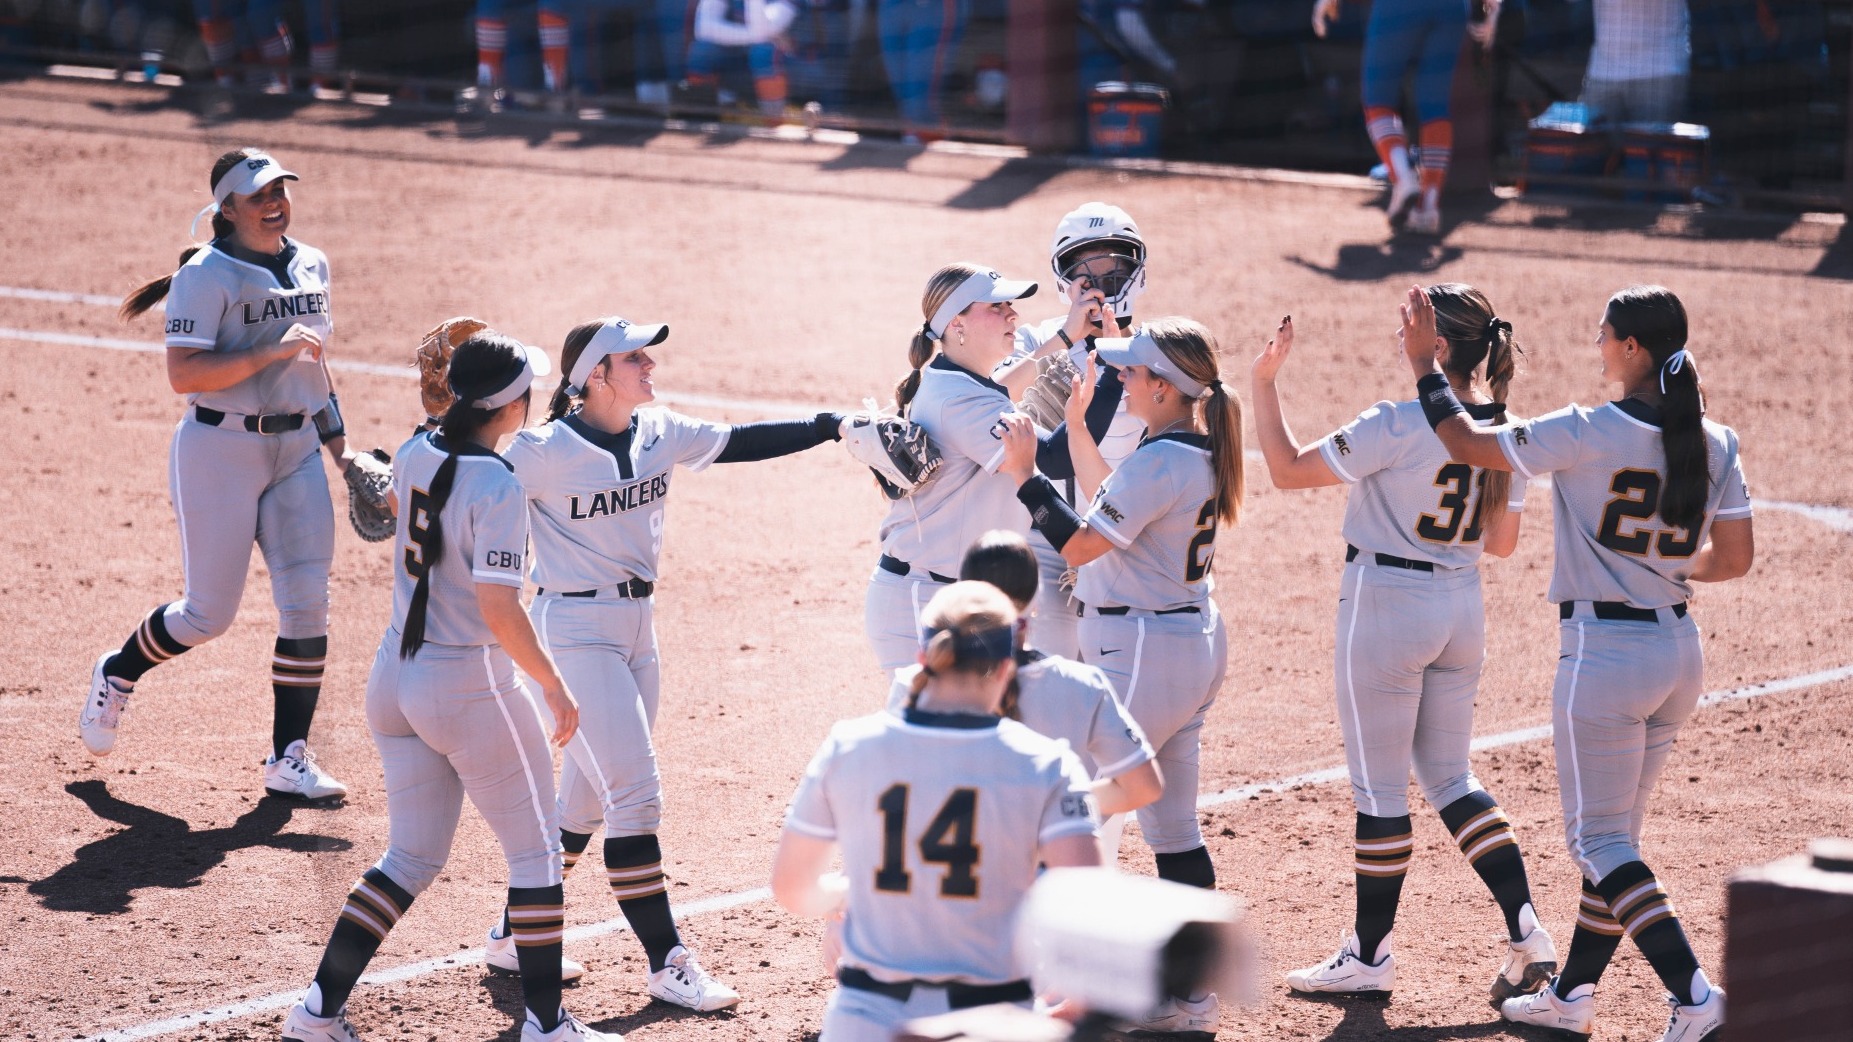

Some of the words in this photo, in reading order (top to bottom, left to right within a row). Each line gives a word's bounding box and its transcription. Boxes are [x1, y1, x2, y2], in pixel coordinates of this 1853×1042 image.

[242, 293, 328, 326] LANCER
[1333, 432, 1351, 456] WAC
[565, 470, 669, 521] LANCERS
[1100, 501, 1125, 524] WAC
[486, 550, 522, 571] CBU
[874, 782, 982, 898] 14
